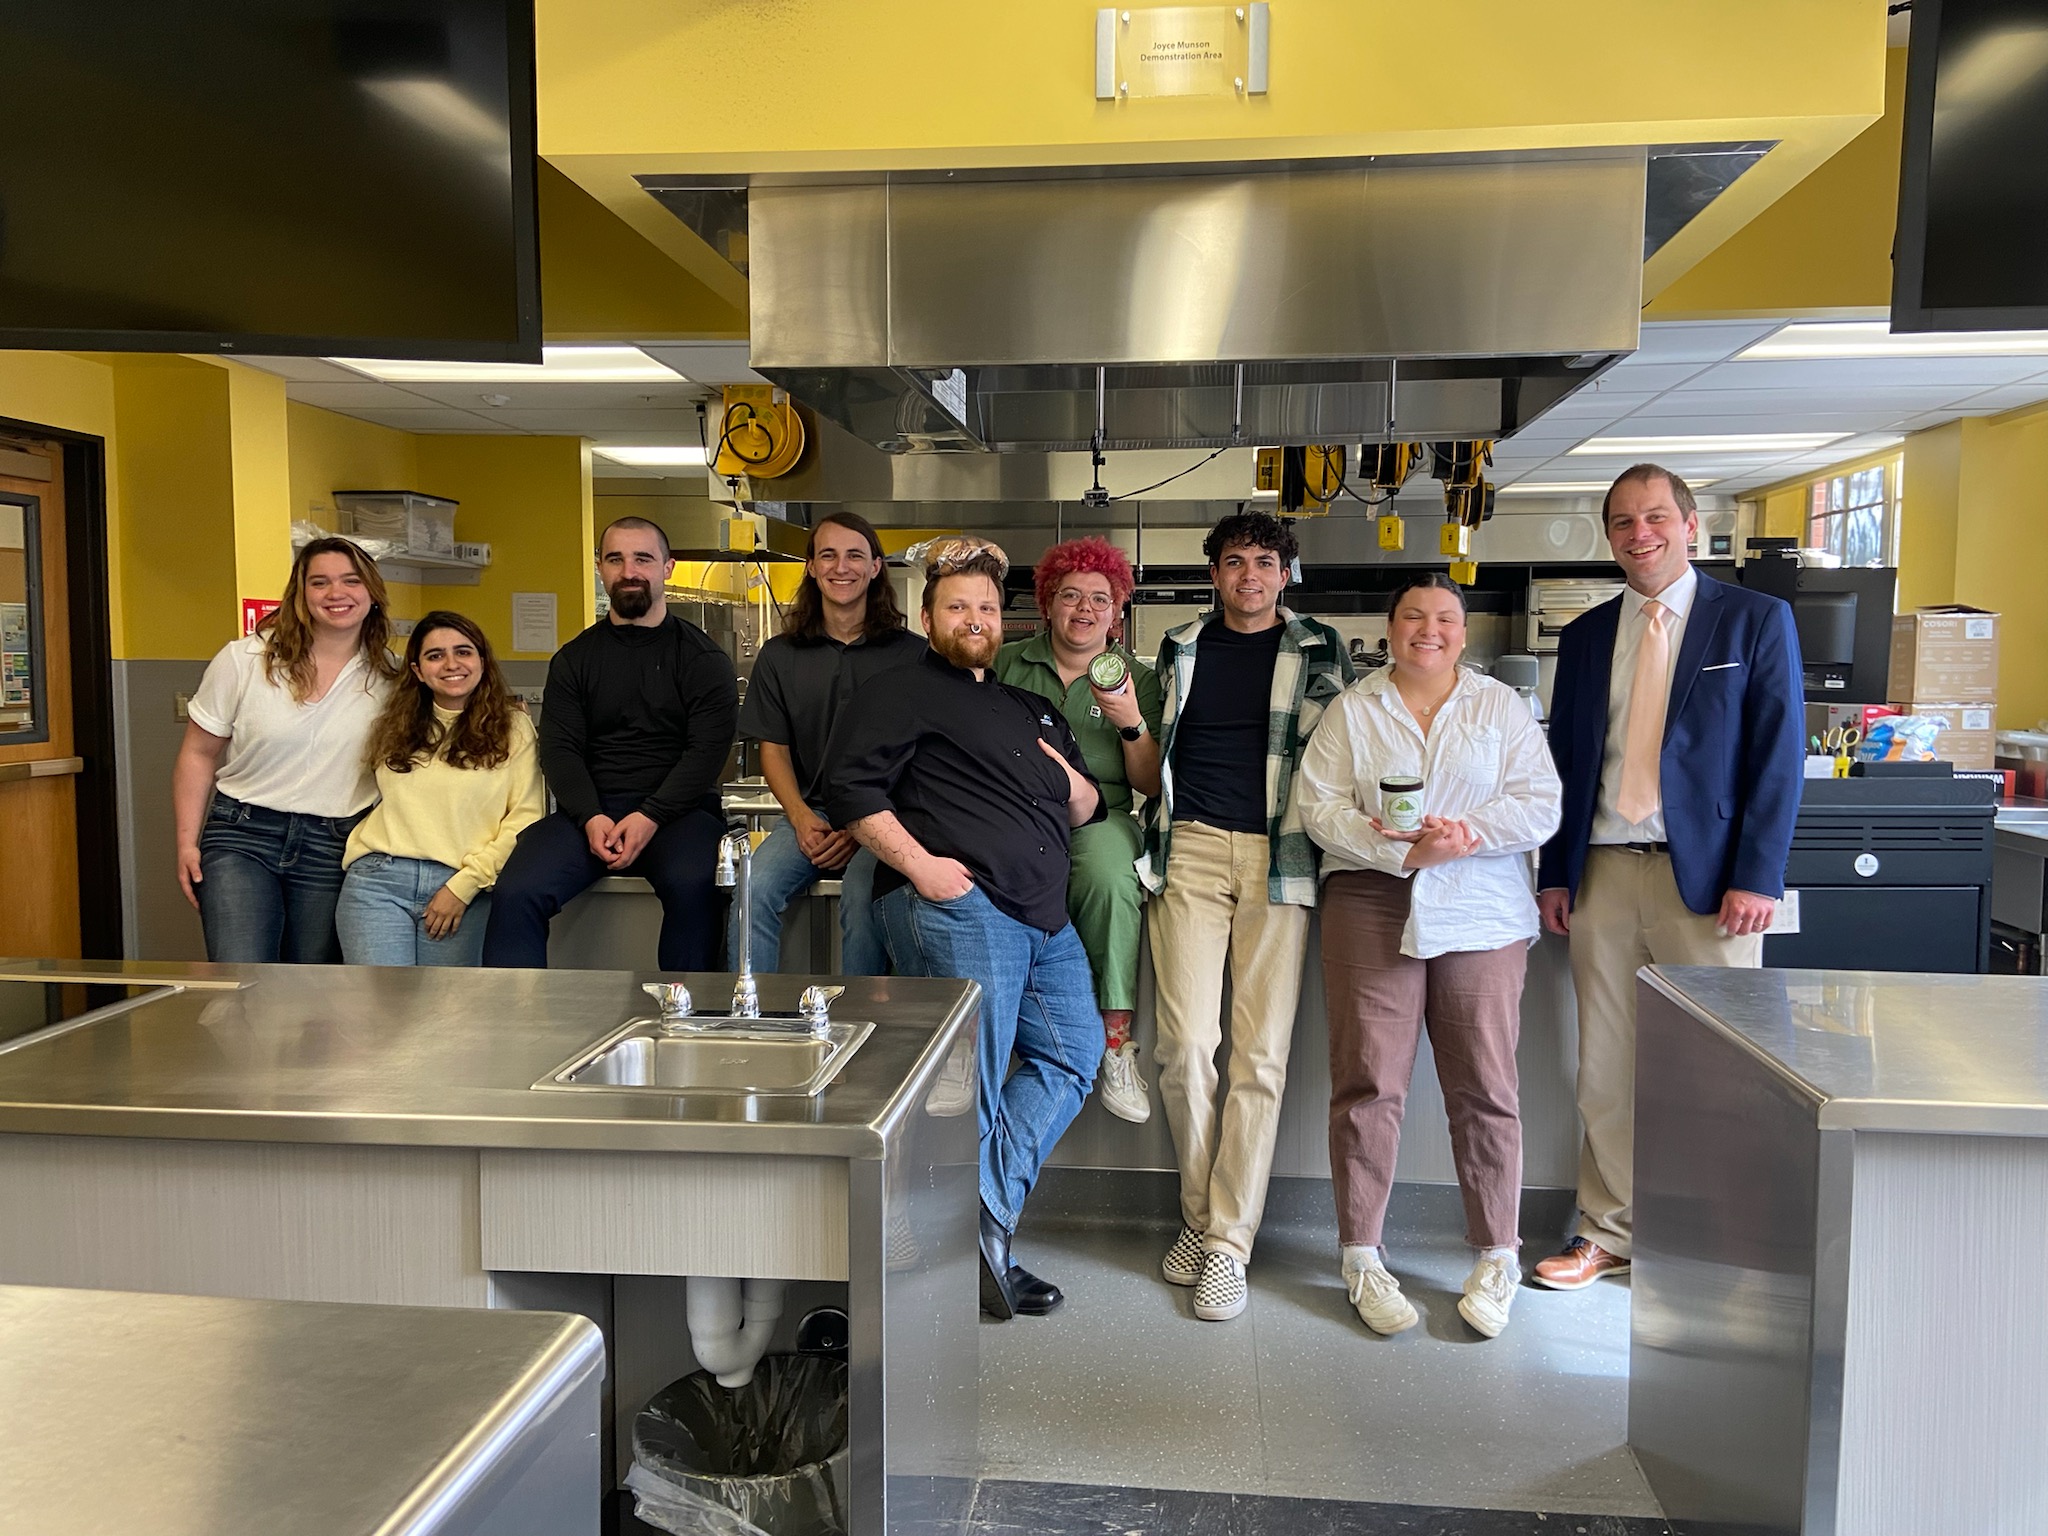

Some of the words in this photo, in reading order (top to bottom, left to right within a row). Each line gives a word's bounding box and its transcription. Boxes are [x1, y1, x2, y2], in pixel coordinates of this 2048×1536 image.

[1153, 42, 1176, 52] Joyce
[1177, 41, 1210, 50] Munson
[1140, 52, 1202, 62] Demonstration
[1203, 51, 1223, 60] Area
[1922, 620, 1958, 628] COSORI
